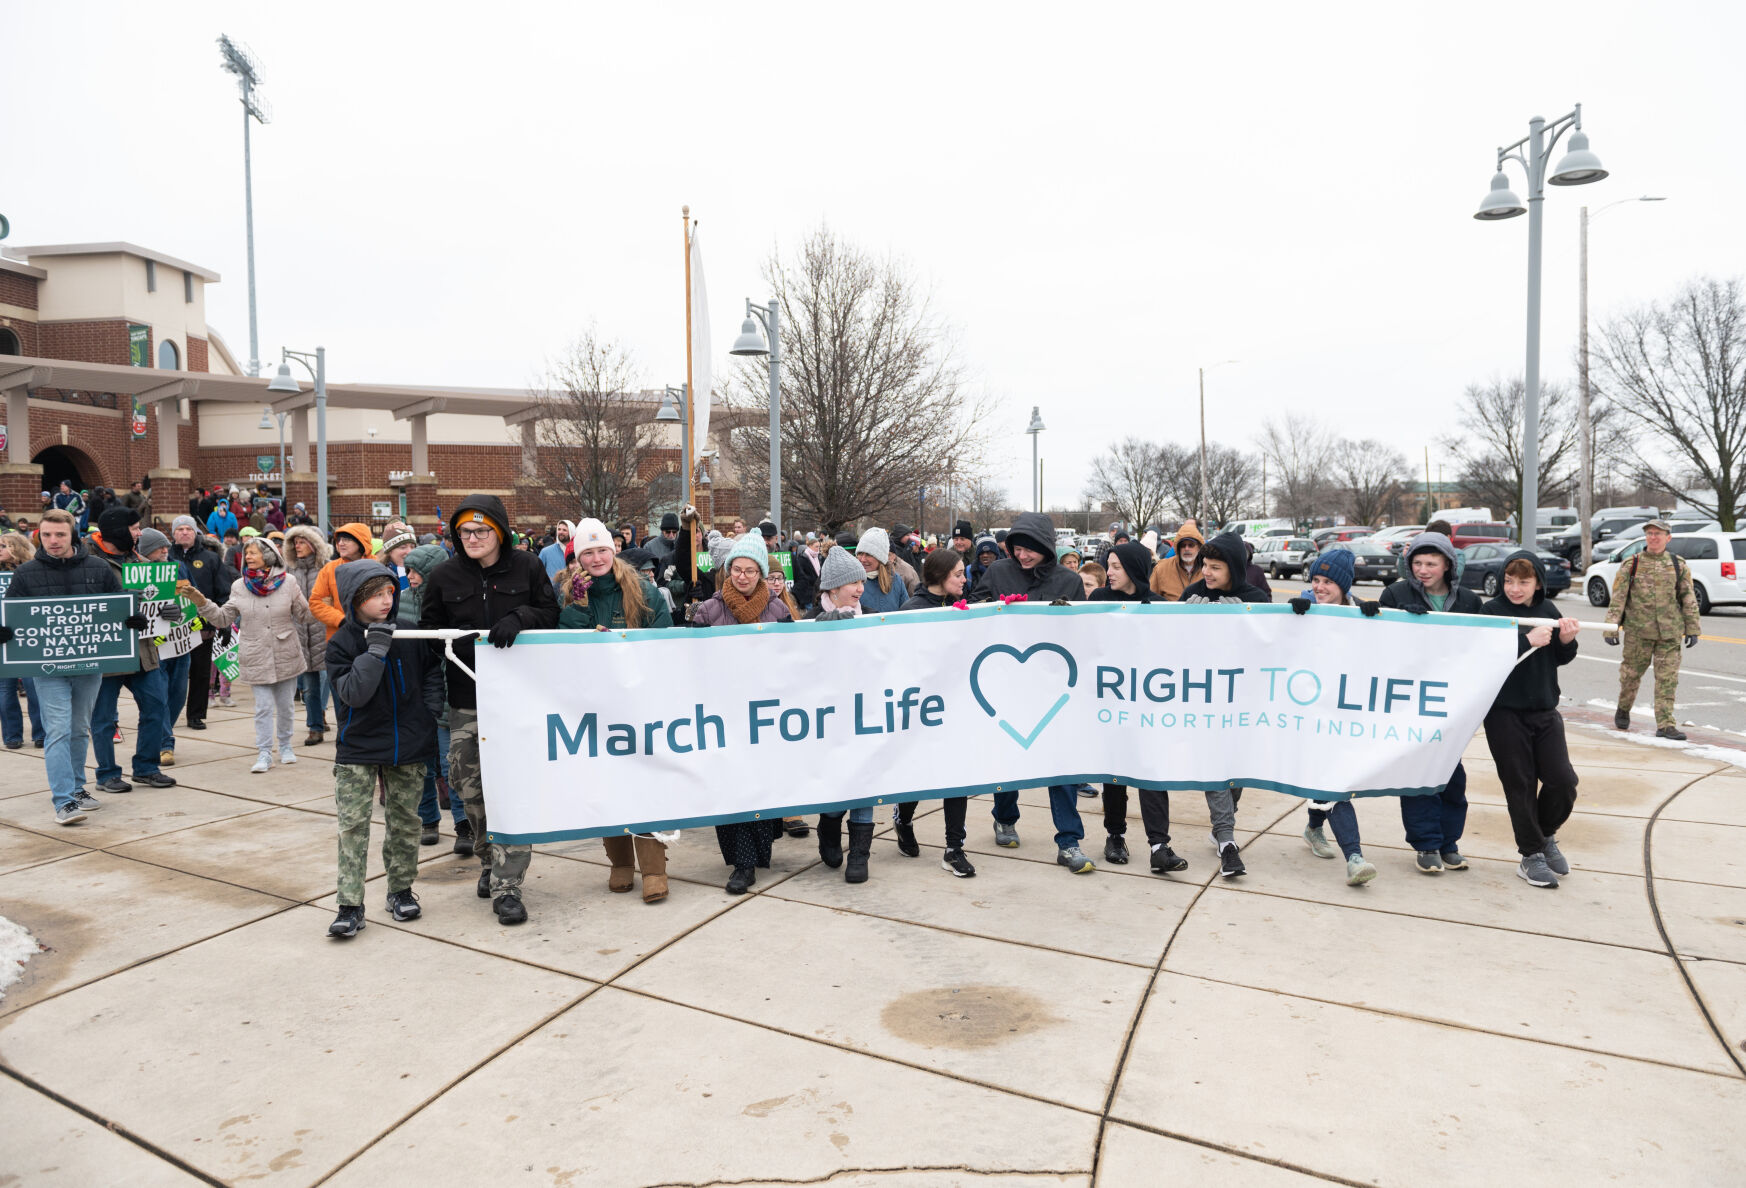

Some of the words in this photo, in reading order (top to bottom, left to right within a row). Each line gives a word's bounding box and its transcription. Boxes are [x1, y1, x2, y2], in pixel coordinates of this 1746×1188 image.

[248, 472, 282, 481] TICKET
[696, 553, 712, 567] OVE
[125, 566, 152, 584] LOVE
[155, 564, 177, 583] LIFE
[30, 602, 108, 616] PRO-LIFE
[46, 613, 93, 626] FROM
[14, 621, 123, 637] CONCEPTION
[15, 638, 39, 647] TO
[45, 632, 123, 647] NATURAL
[174, 637, 192, 656] LIFE
[42, 644, 98, 657] DEATH
[1096, 665, 1245, 704] RIGHT
[1260, 667, 1322, 706] TO
[1337, 673, 1449, 718] LIFE
[546, 682, 726, 762] March
[748, 698, 836, 745] For
[854, 686, 945, 736] Life
[1097, 708, 1129, 726] OF
[1140, 711, 1305, 732] NORTHEAST
[1316, 718, 1443, 744] INDIANA
